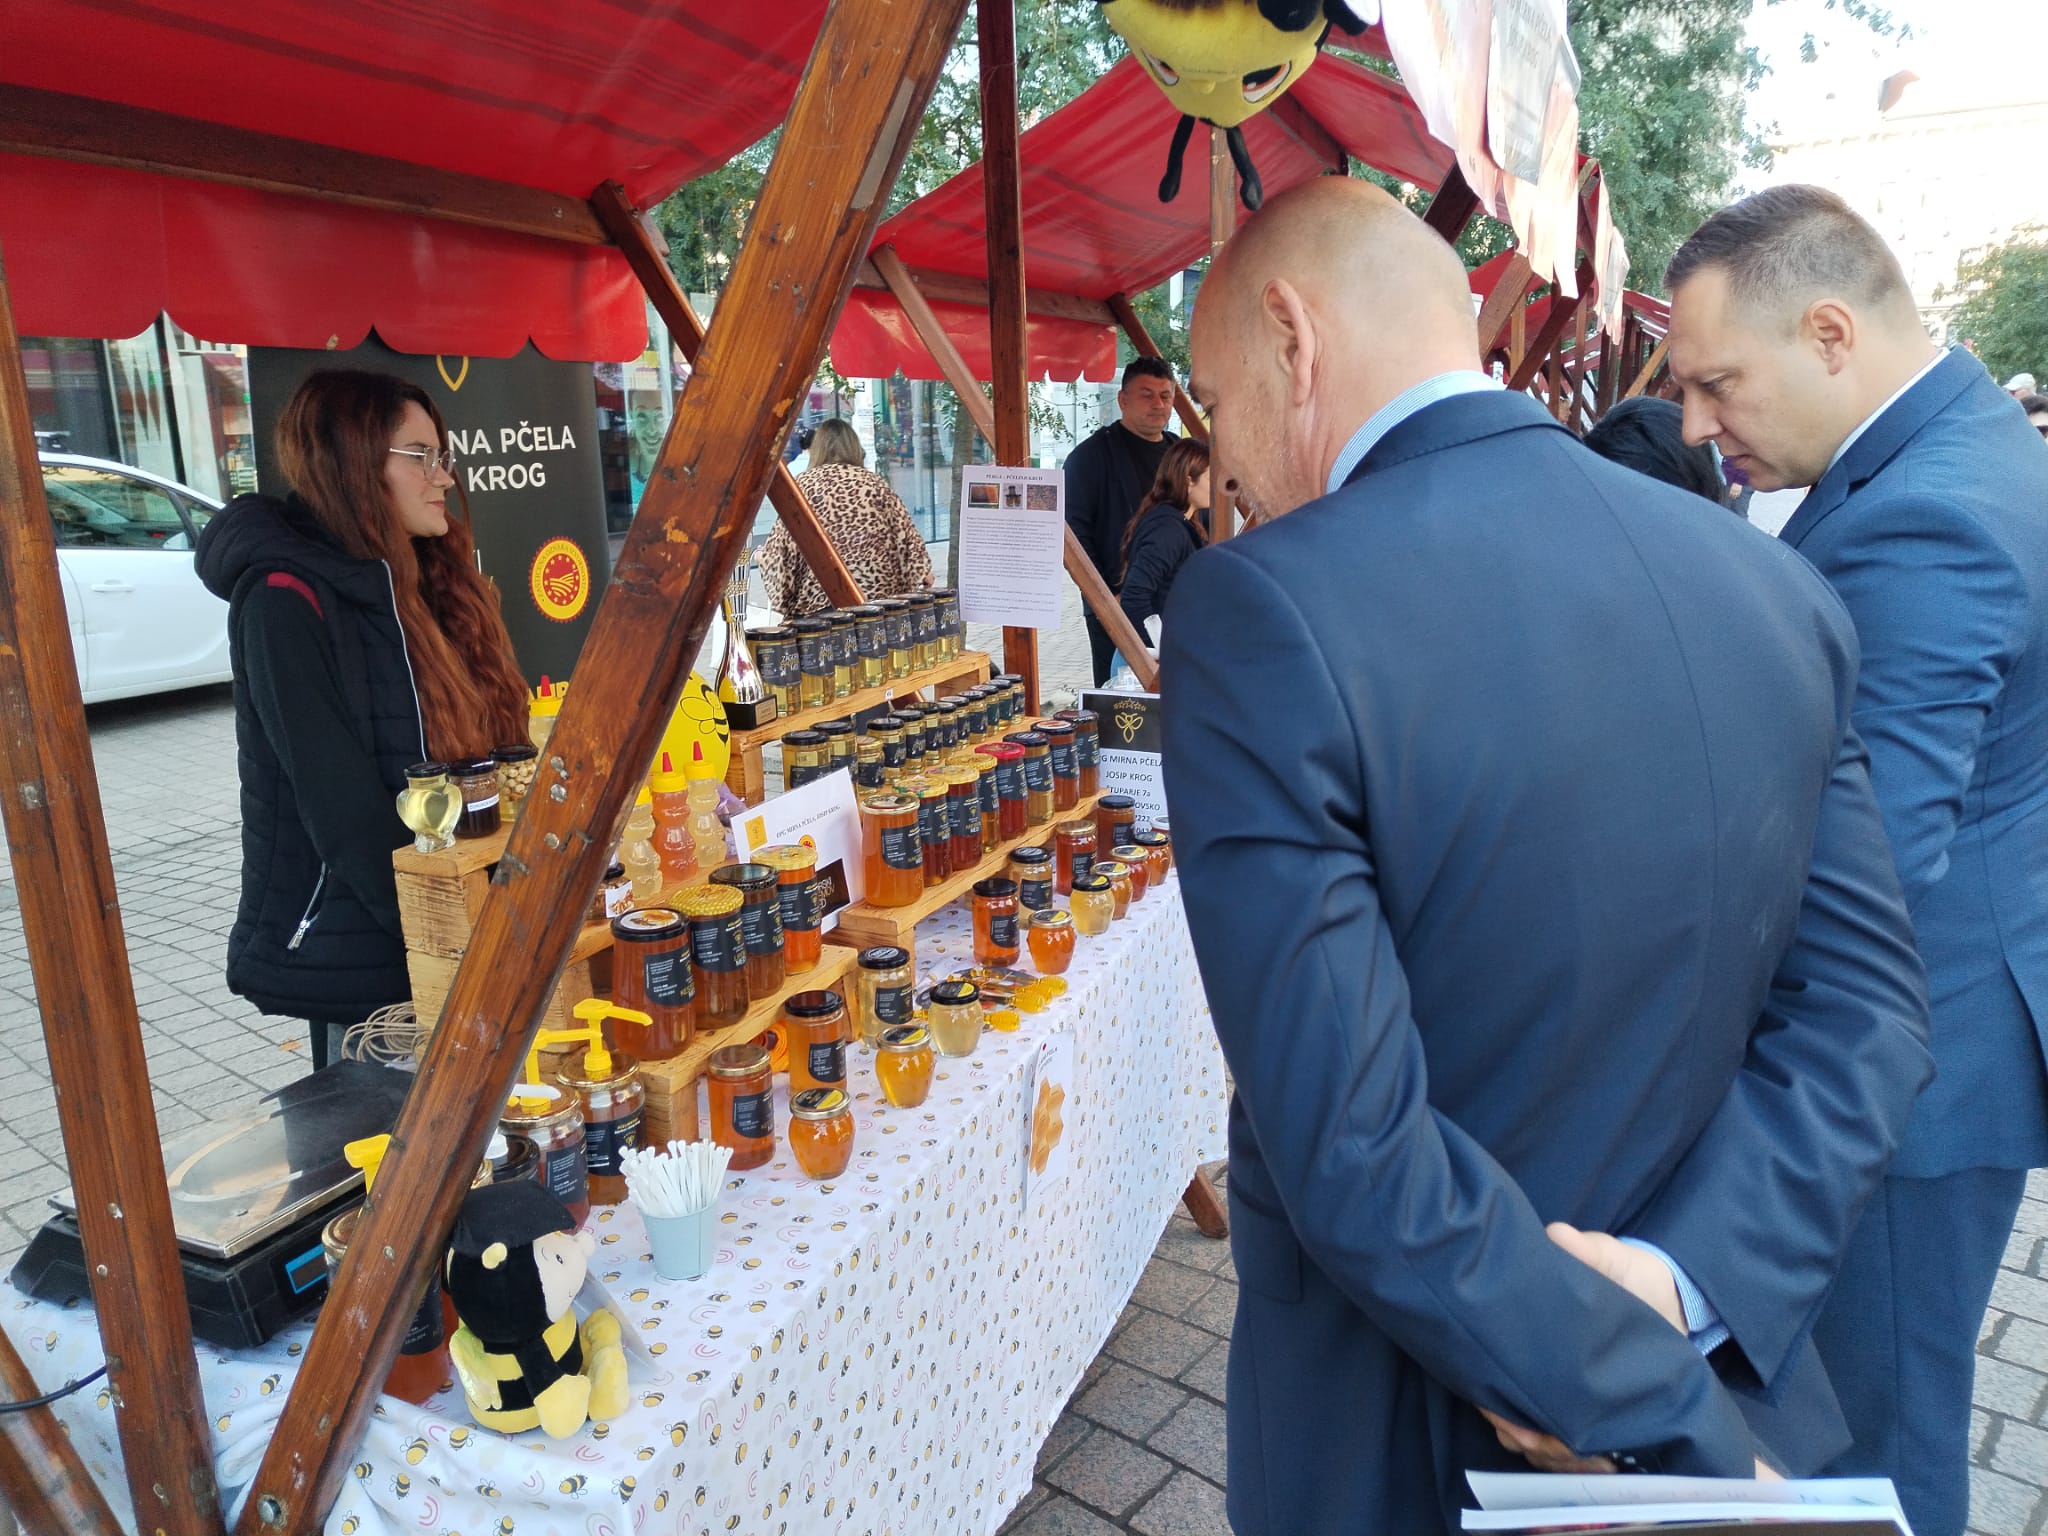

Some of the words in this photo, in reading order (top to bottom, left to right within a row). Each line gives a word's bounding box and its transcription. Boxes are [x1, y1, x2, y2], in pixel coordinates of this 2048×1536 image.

[500, 420, 577, 453] PČELA
[467, 462, 546, 493] KROG
[1109, 755, 1138, 765] MIRNA
[1105, 770, 1128, 780] JOSIP
[1129, 773, 1153, 782] KROG
[1106, 785, 1141, 797] TUPARJE
